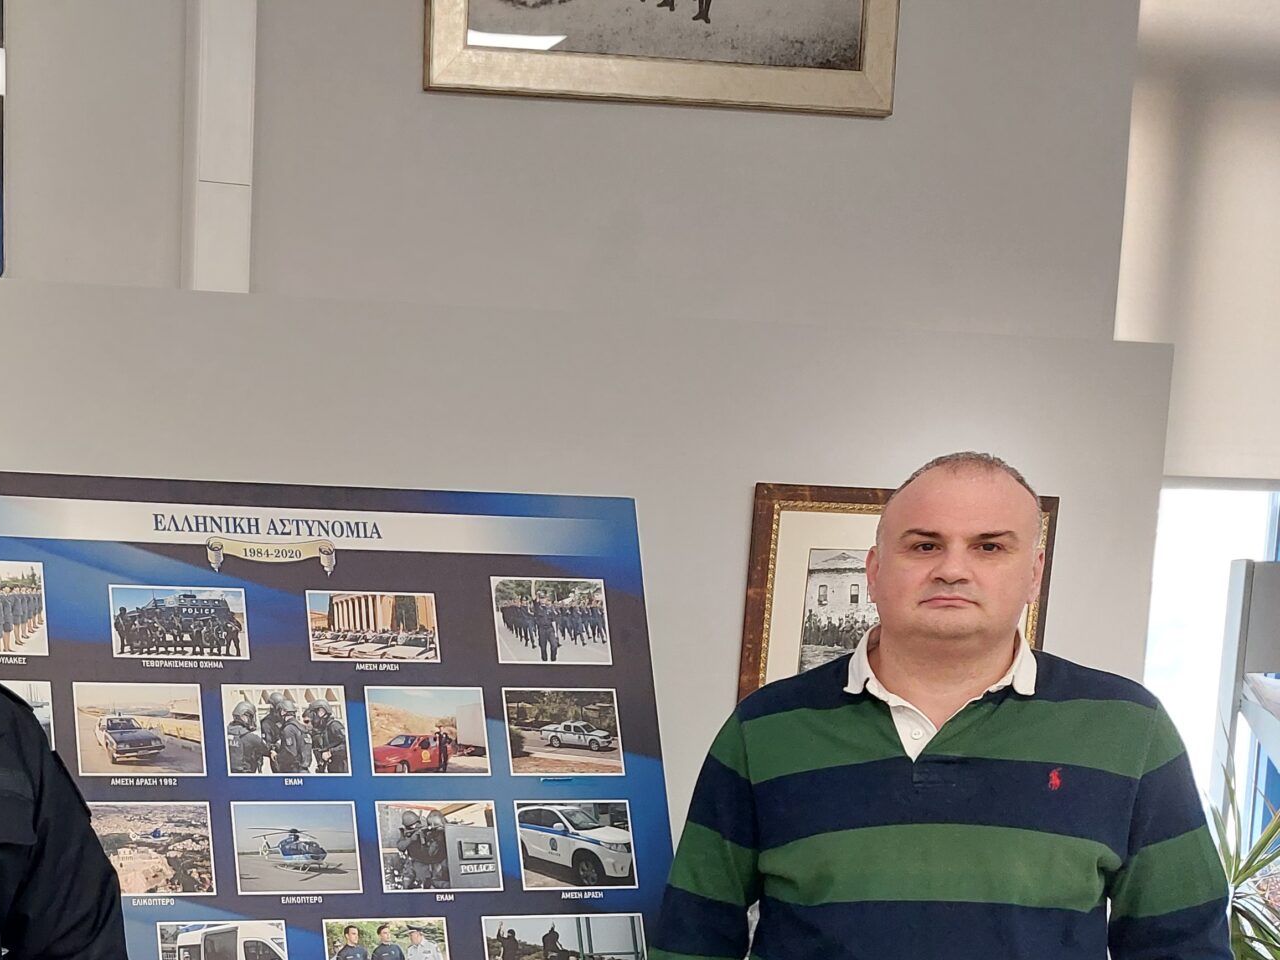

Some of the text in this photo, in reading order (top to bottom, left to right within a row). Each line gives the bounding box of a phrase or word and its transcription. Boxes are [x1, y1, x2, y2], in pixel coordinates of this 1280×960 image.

[152, 513, 382, 540] ΕΛΛΗΝΙΚΗ ΑΣΤΥΝΟΜΙΑ
[242, 547, 302, 559] 1984-2020
[200, 660, 224, 669] ΟΧΗΜΑ
[355, 662, 400, 671] ΑΜΕΣΗ ΔΡΑΣΗ
[110, 778, 135, 786] ΑΜΕΣΗ
[135, 778, 158, 786] ΔΡΑΣΗ
[284, 778, 303, 786] ΕΚΑΜ
[460, 863, 496, 873] POLICE
[436, 894, 454, 902] ΕΚΑΜ
[561, 891, 604, 899] ΑΜΕΣΗ ΔΡΑΣΗ
[132, 898, 175, 906] ΕΛΙΚΟΠΤΕΡΟ
[281, 896, 323, 904] ΕΛΙΚΟΠΤΕΡΟ
